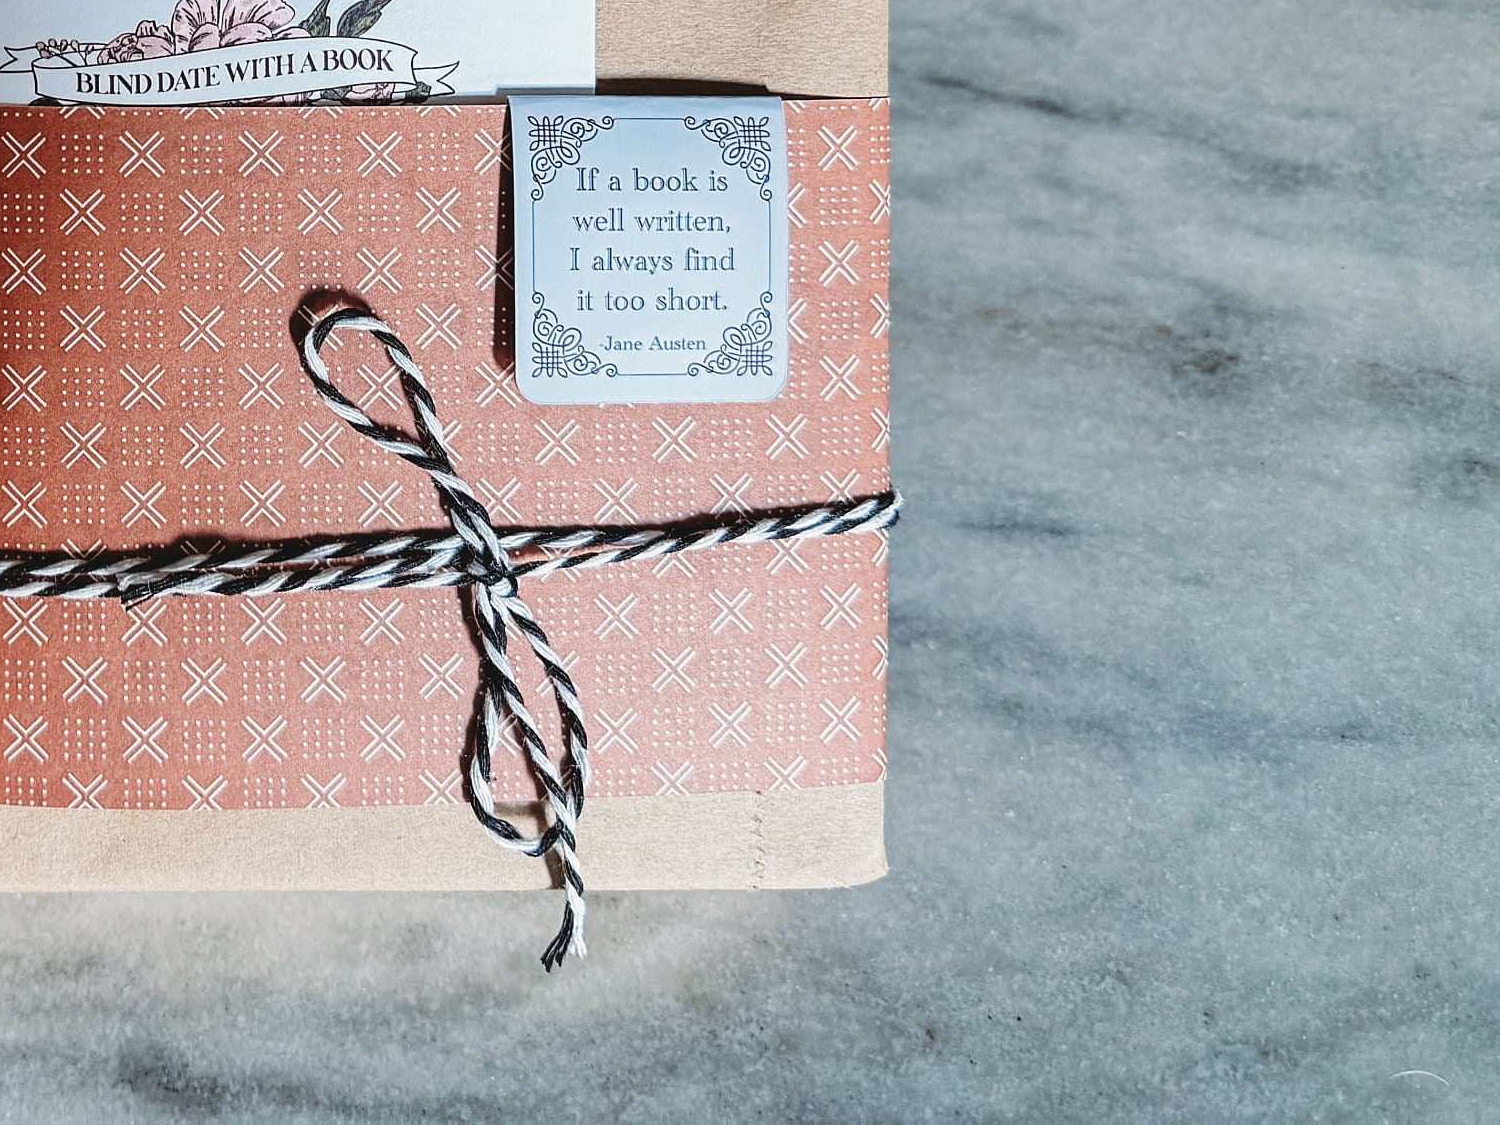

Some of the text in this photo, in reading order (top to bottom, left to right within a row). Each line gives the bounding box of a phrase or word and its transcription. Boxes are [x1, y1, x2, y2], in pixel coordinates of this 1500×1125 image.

[76, 48, 394, 95] BLIND DATE WITH A BOOK
[575, 167, 729, 192] If a book is
[572, 207, 732, 234] well written,
[569, 247, 735, 276] I always find
[576, 287, 728, 311] it too short.
[598, 335, 707, 352] -Jane Austen
